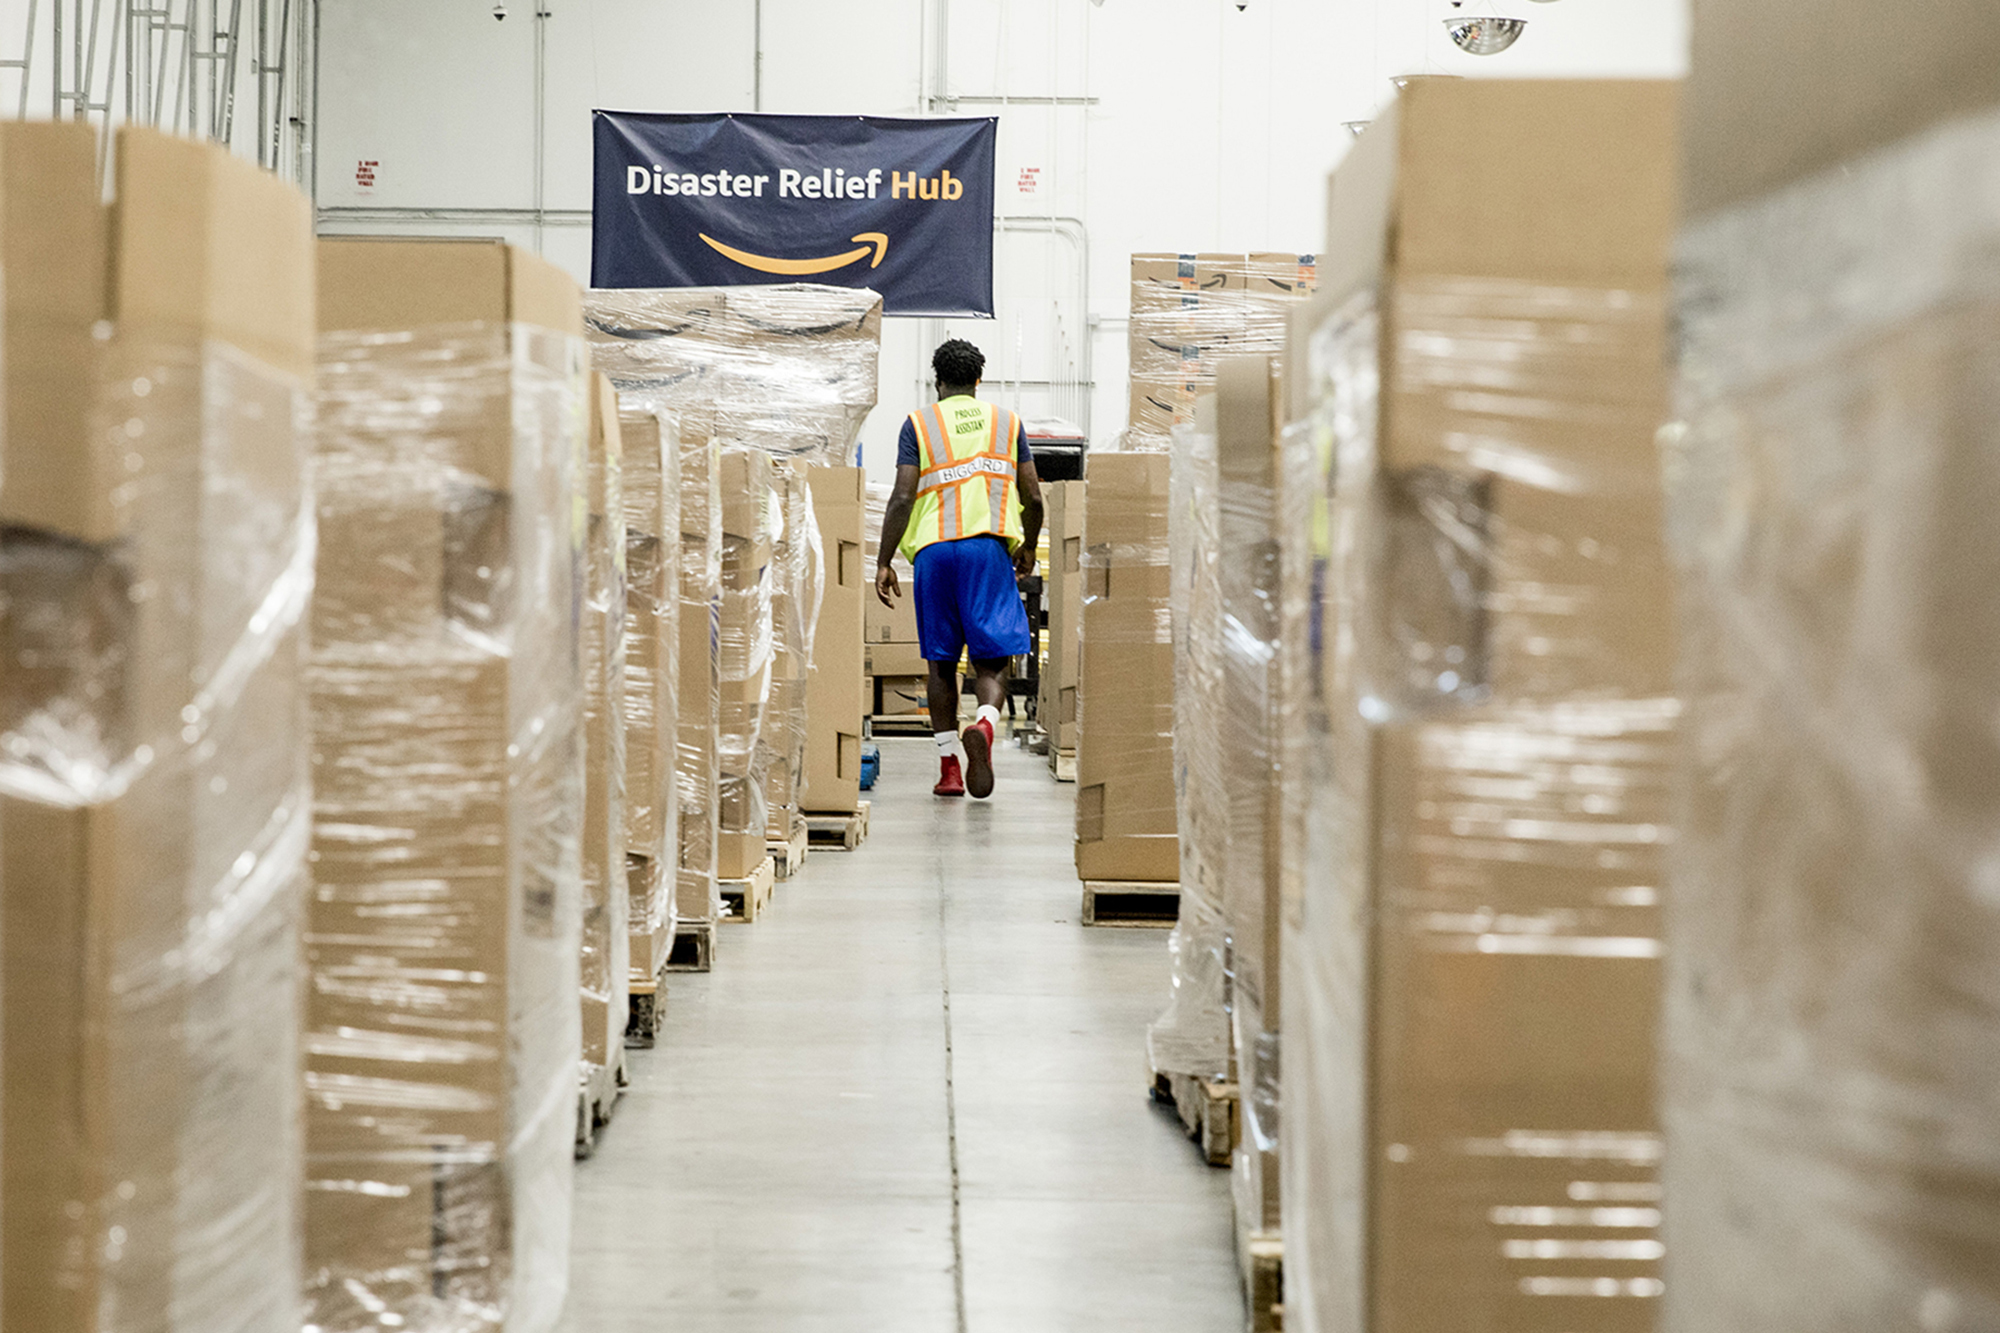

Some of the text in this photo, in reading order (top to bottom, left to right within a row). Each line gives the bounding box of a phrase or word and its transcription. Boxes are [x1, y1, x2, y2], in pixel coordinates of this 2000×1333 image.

[626, 165, 964, 201] Disaster Relief Hub
